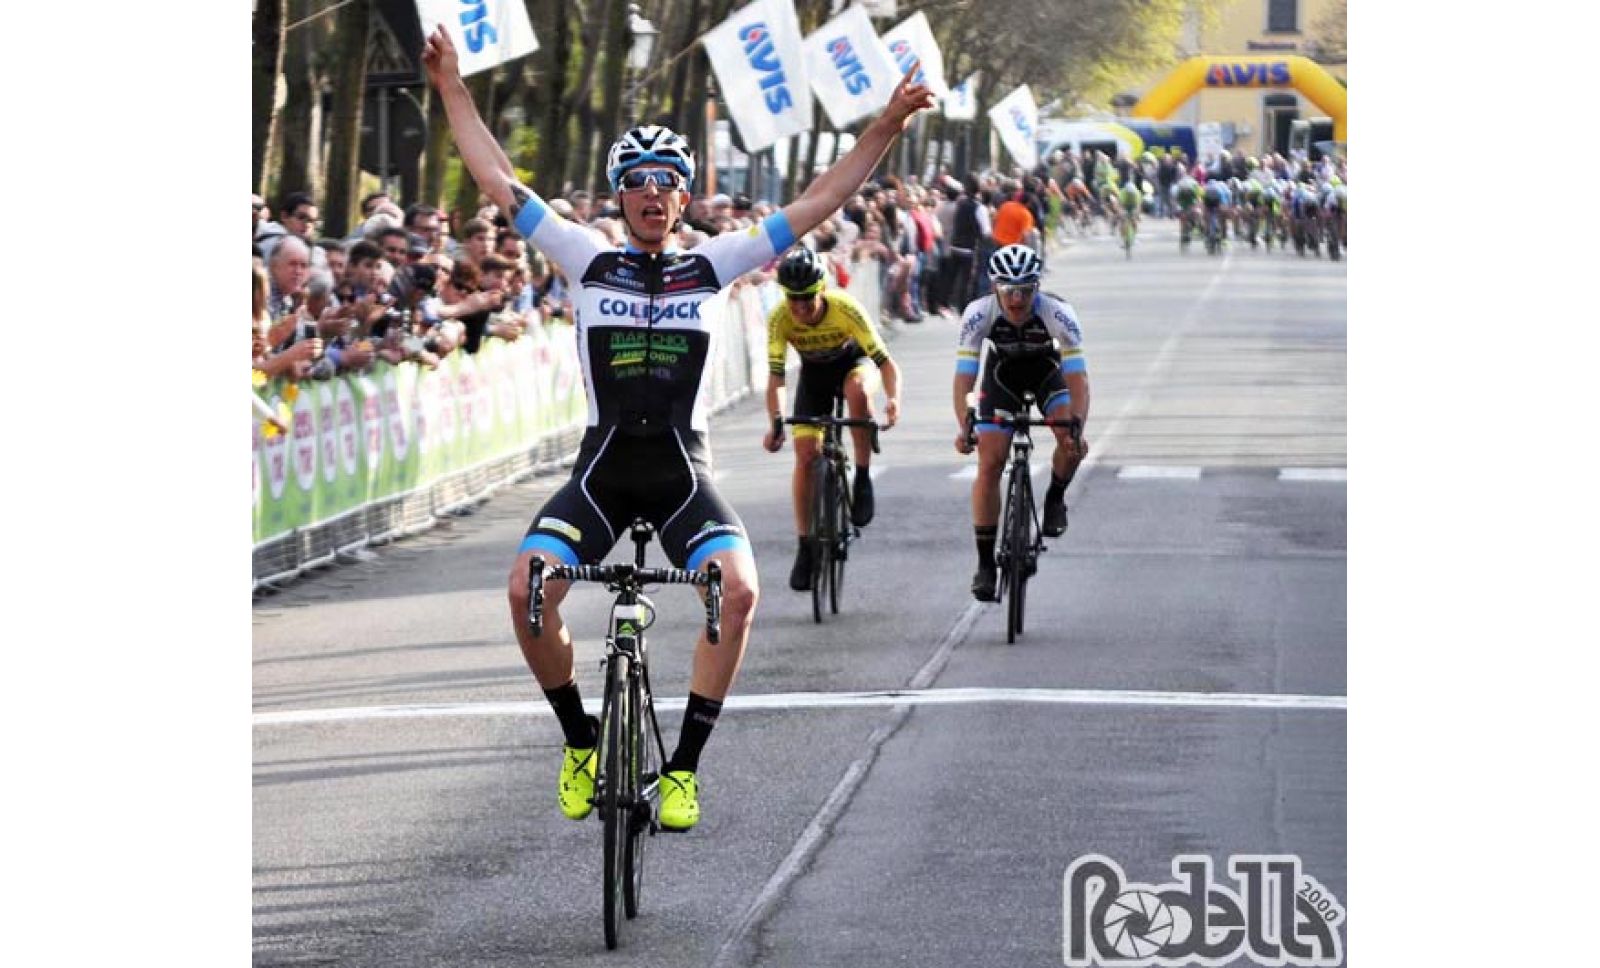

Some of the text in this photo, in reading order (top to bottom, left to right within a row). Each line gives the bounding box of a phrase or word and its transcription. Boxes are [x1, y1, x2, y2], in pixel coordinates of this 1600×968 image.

[459, 0, 498, 54] IS
[739, 22, 792, 114] AVIS
[827, 36, 872, 95] AVIS
[1206, 63, 1290, 86] AVIS
[599, 297, 702, 324] COLPACK
